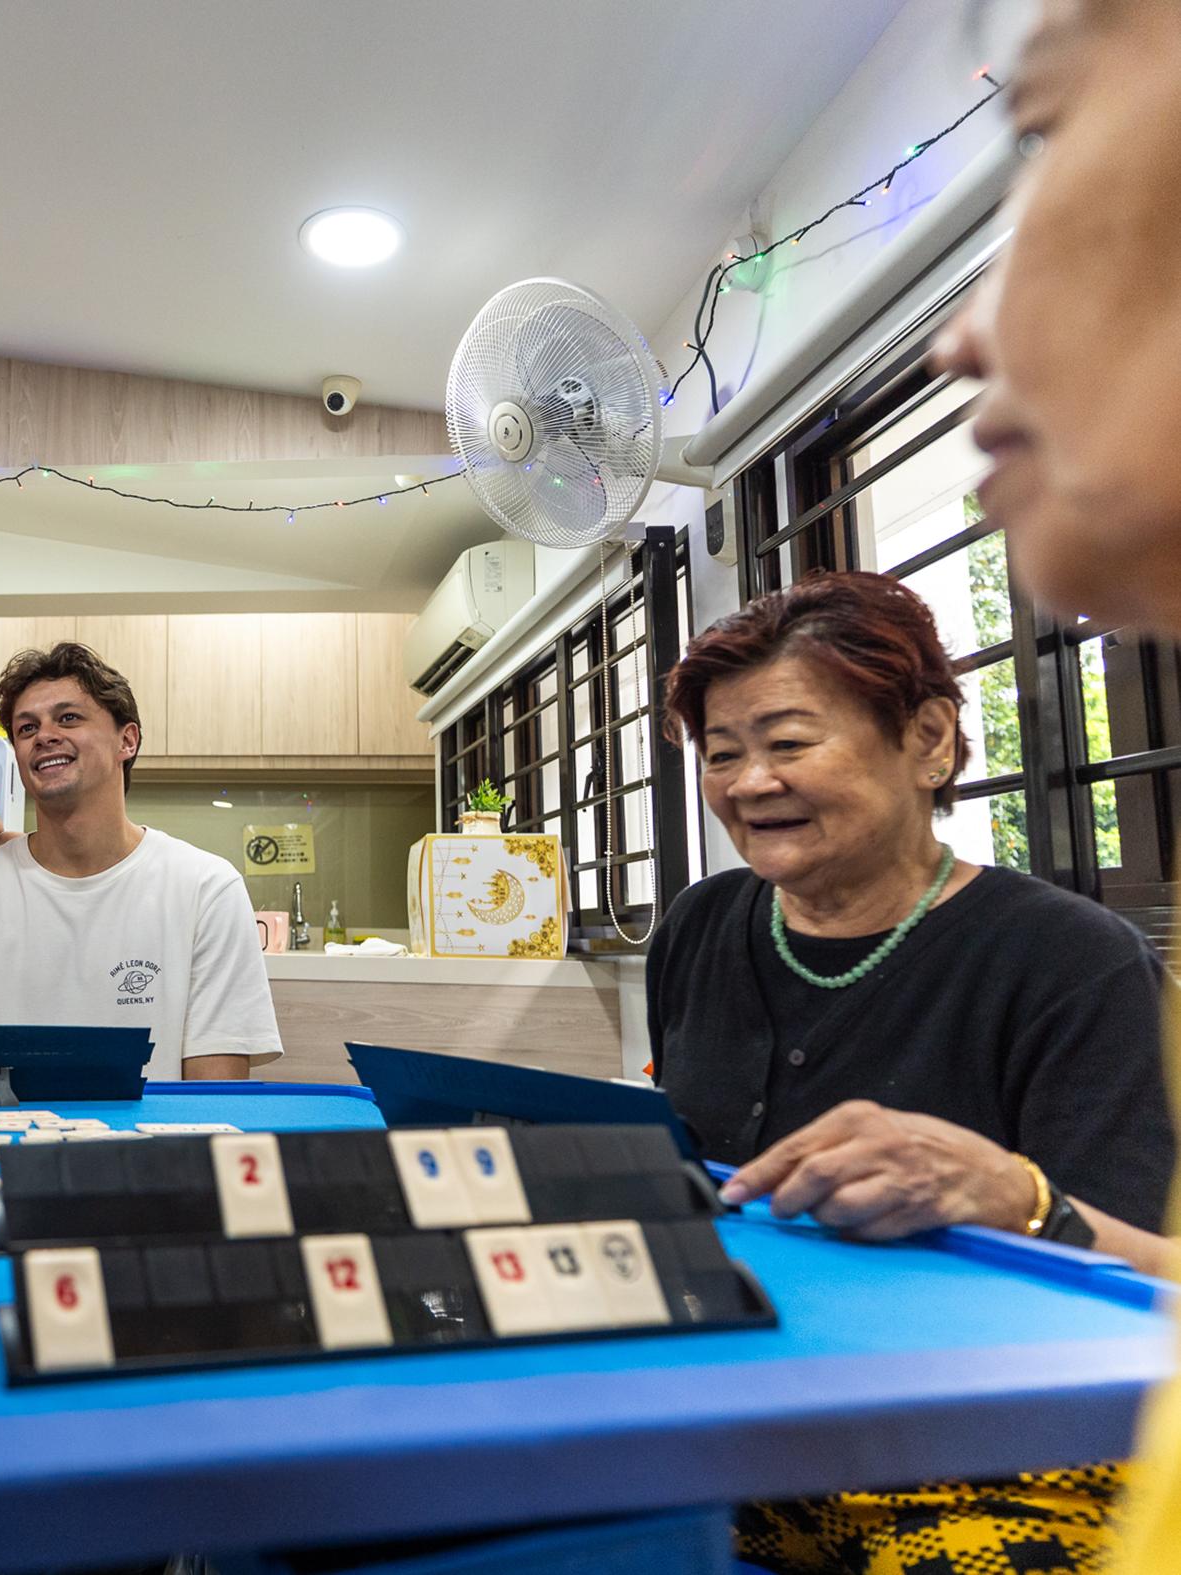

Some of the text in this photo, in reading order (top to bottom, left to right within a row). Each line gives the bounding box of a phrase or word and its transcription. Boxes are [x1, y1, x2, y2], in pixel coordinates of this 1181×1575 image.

[125, 960, 144, 968] LEON
[239, 1154, 261, 1186] 2
[418, 1149, 440, 1179] 9
[474, 1147, 496, 1177] 9
[325, 1256, 361, 1291] 12
[54, 1273, 80, 1311] 6
